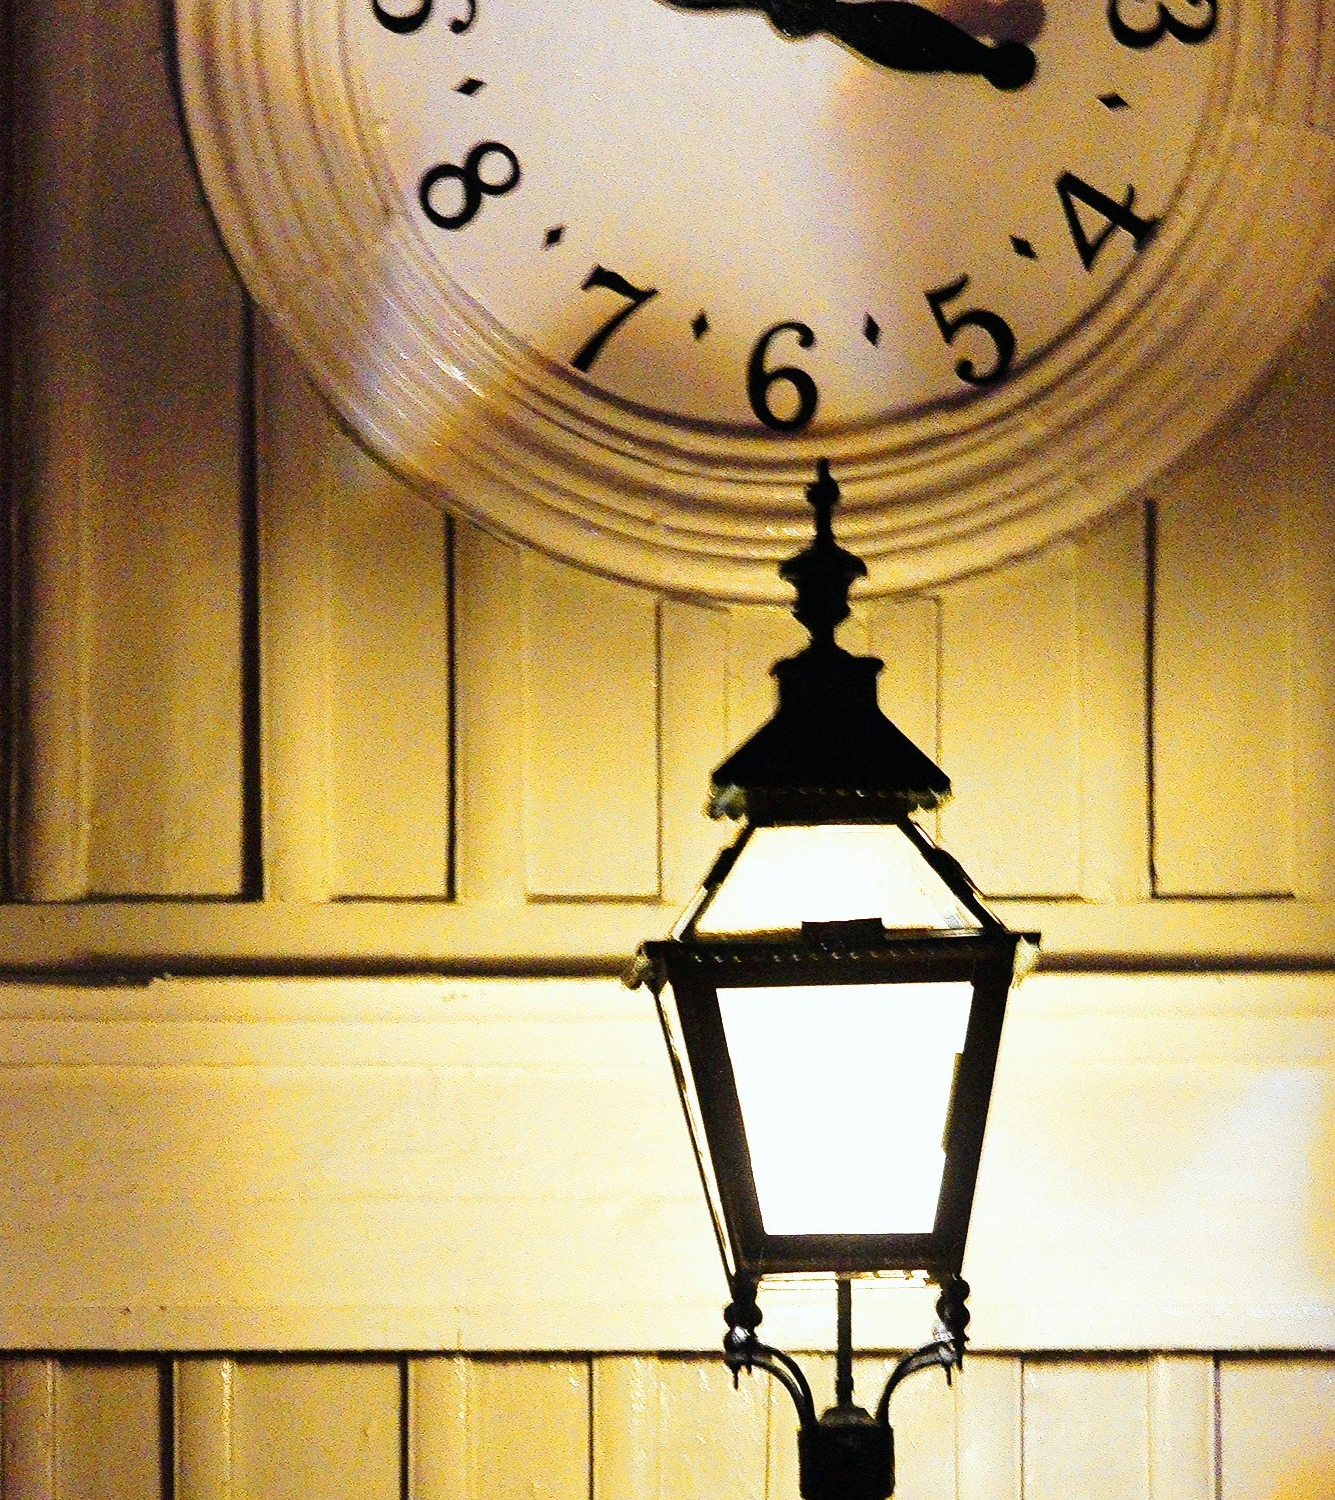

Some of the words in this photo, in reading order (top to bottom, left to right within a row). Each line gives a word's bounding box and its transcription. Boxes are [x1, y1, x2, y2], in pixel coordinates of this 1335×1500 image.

[418, 141, 521, 231] 8
[1054, 171, 1160, 272] 4
[569, 265, 658, 373] 7
[924, 275, 1018, 387] 5
[746, 321, 820, 433] 6
